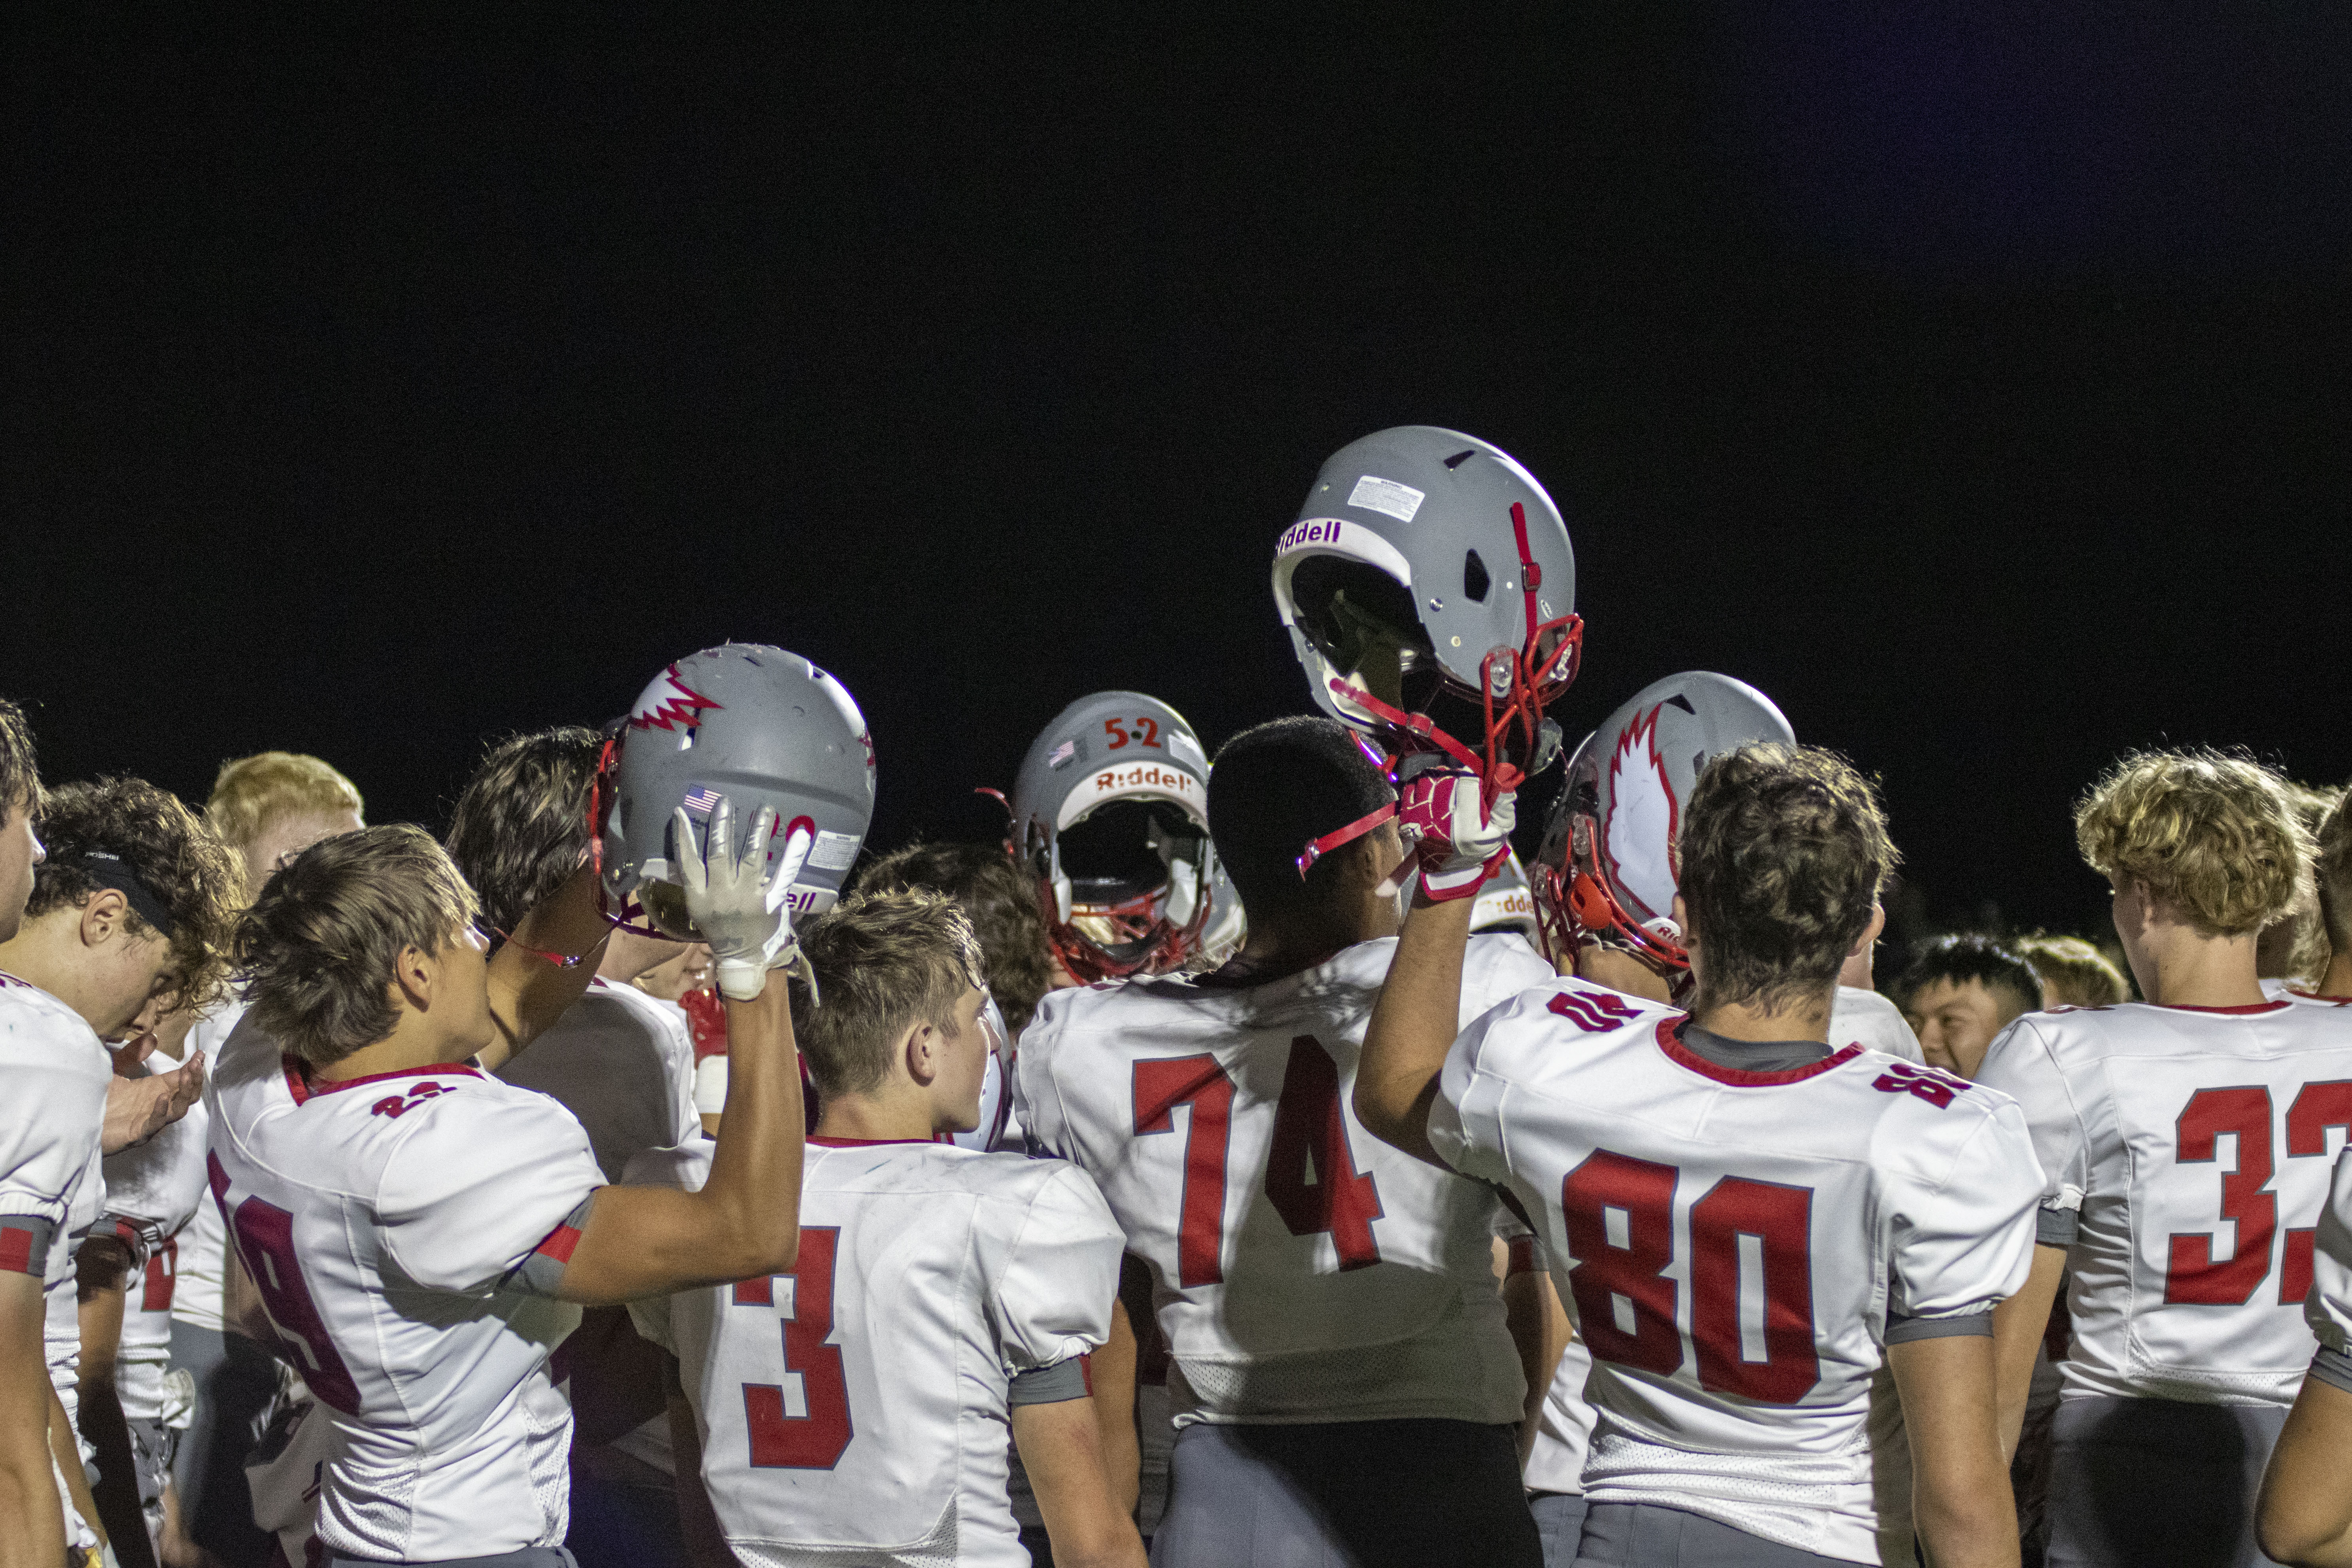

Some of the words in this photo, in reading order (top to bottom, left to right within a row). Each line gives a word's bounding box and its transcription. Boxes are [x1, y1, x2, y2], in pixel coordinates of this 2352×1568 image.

[1275, 521, 1341, 554] iddell
[1131, 1052, 1385, 1290] 74
[1561, 1148, 1821, 1407] 80
[732, 1225, 855, 1470] 3
